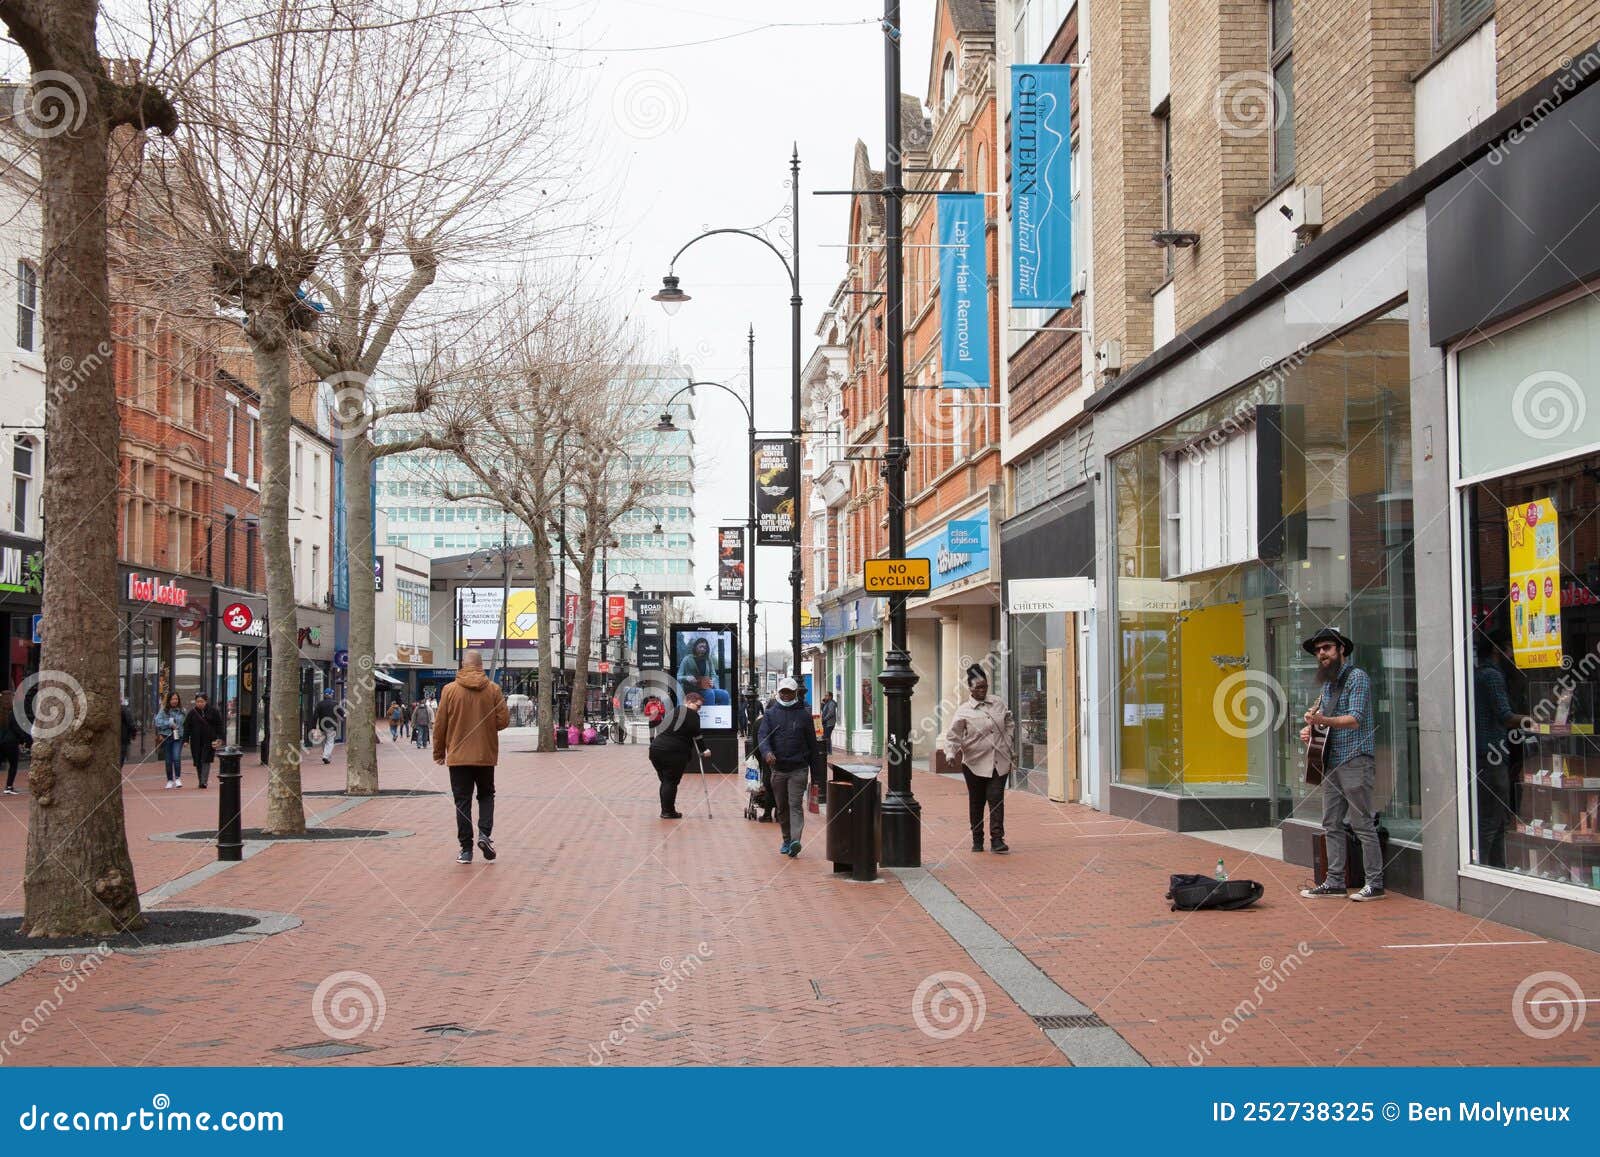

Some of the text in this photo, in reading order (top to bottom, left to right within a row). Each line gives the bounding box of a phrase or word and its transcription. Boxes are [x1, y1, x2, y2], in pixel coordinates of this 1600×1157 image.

[1019, 73, 1037, 296] CHILTERN medical clinic
[955, 221, 973, 361] Laser Hair Removal
[888, 564, 907, 574] NO
[129, 572, 188, 607] Foot Locker
[870, 576, 925, 586] CYCLING
[1013, 602, 1055, 610] CHILTERN
